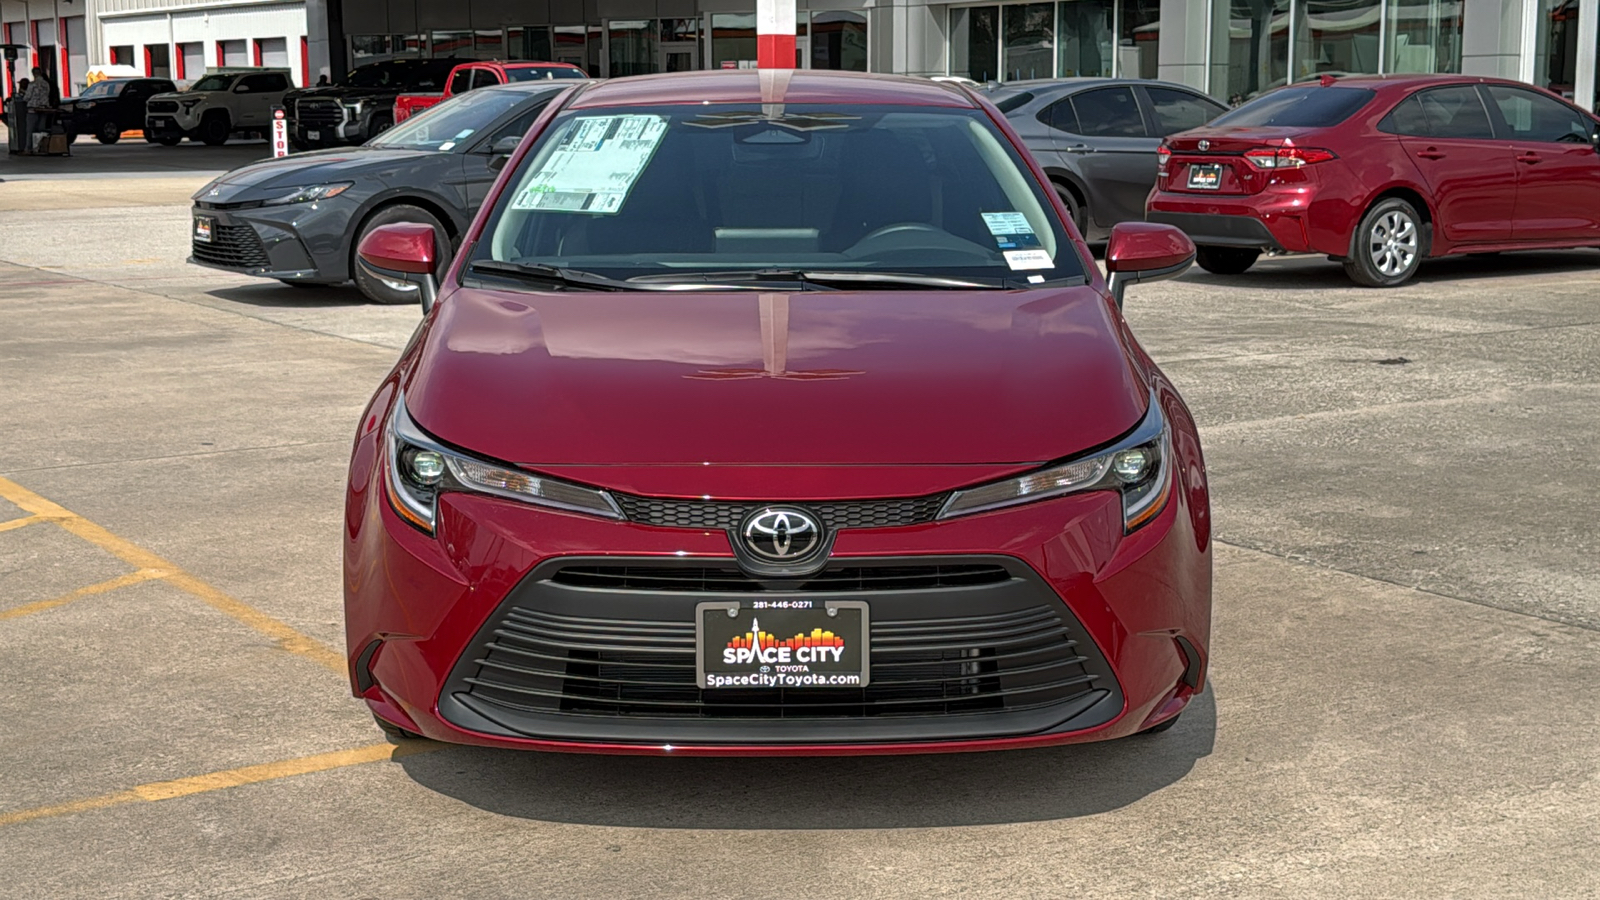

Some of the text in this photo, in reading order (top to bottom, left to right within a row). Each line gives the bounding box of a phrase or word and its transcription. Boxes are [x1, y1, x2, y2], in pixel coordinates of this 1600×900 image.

[276, 121, 285, 157] STOP
[723, 646, 845, 663] SPACE CITY
[707, 673, 859, 687] SpaceCityToyota.com
